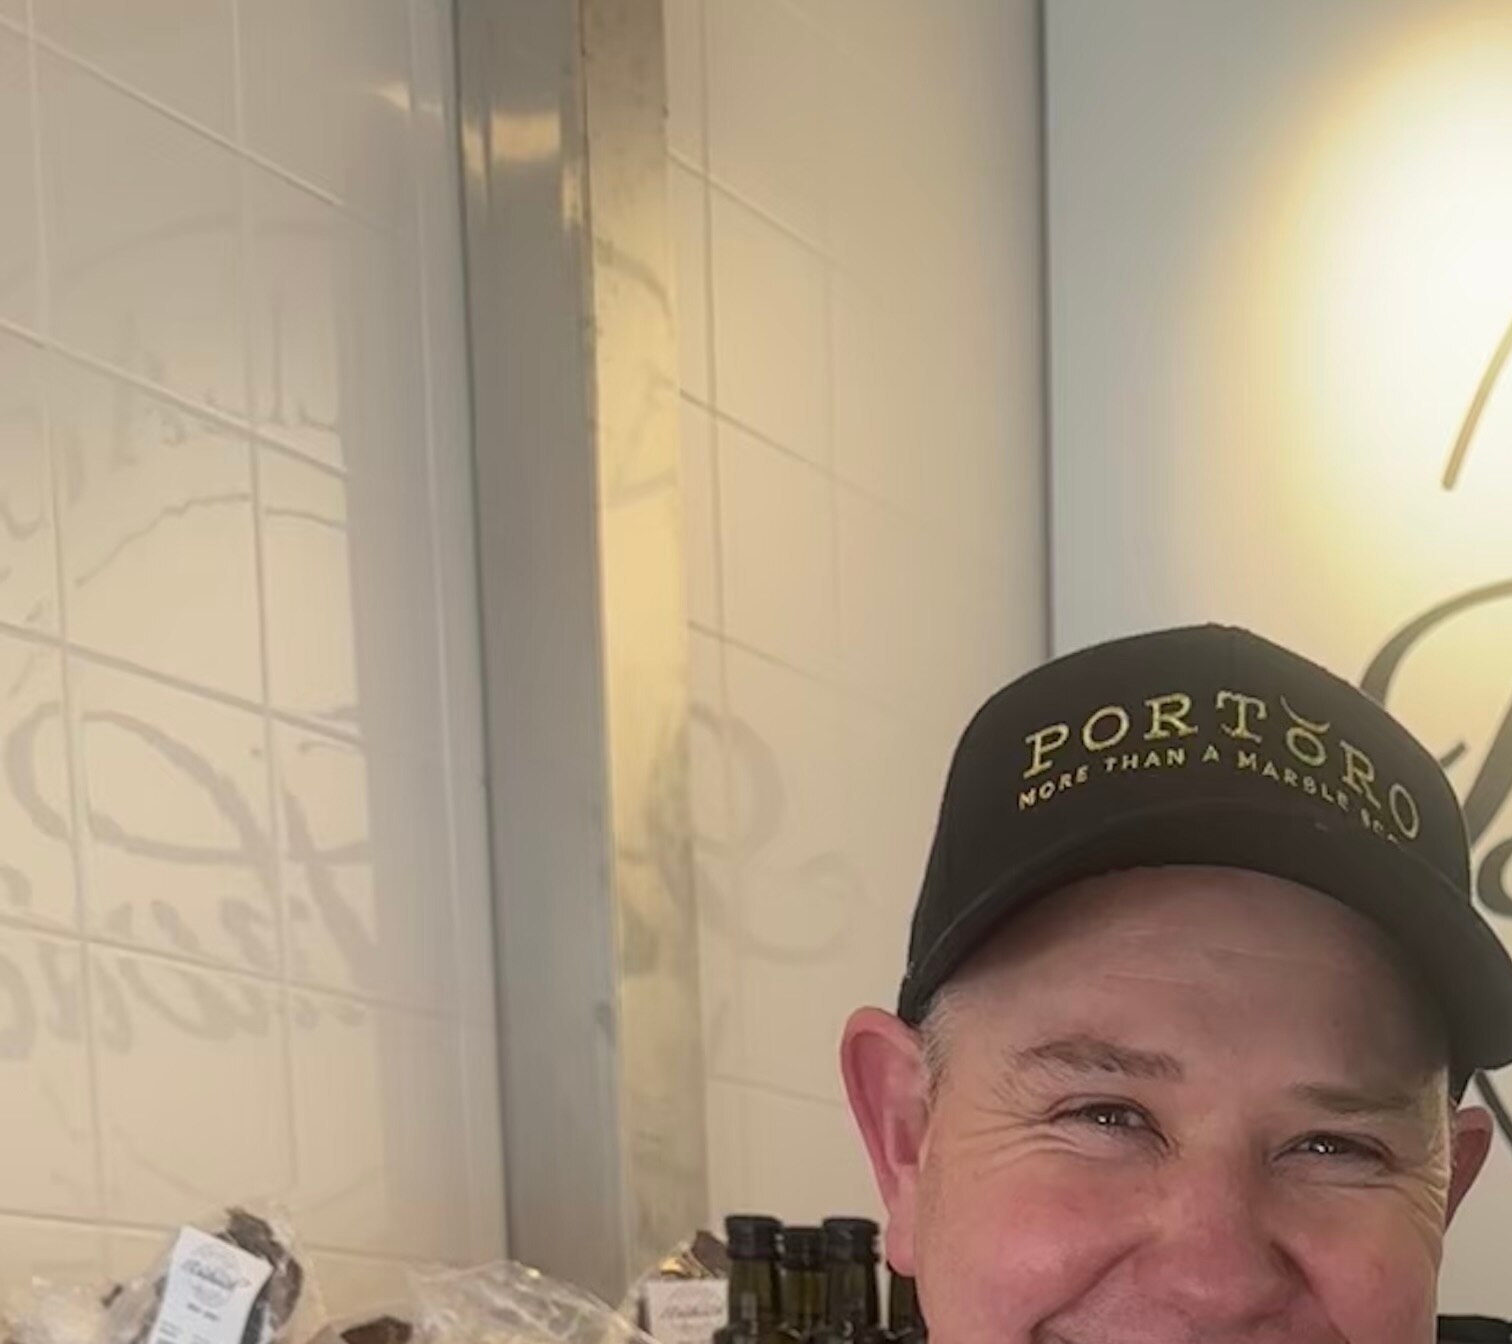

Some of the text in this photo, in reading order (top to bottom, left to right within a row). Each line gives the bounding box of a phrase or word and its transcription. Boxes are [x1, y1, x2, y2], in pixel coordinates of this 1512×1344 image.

[1104, 747, 1186, 773] THAN
[1201, 744, 1220, 763] A
[1237, 750, 1350, 813] MARBLE
